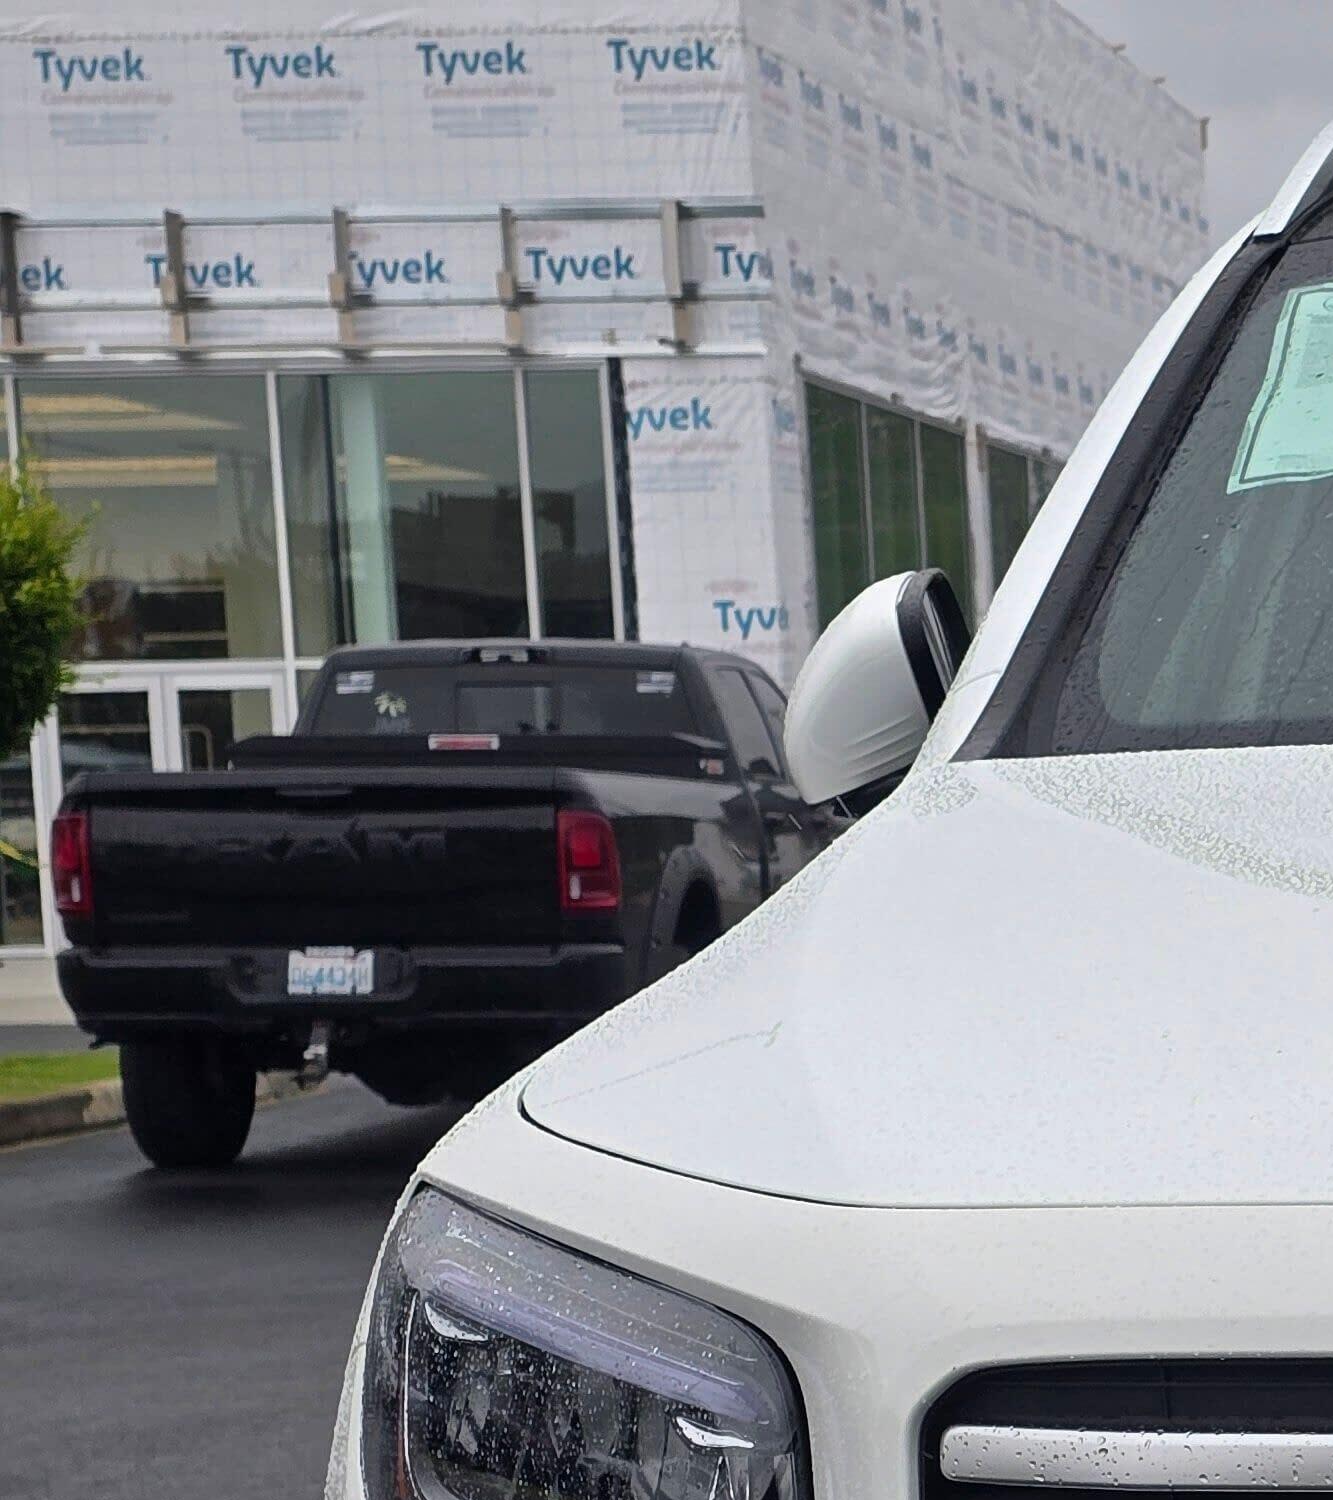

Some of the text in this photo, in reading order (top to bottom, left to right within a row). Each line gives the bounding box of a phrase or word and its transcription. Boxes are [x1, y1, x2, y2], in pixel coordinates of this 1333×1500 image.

[33, 47, 146, 91] Tyvek
[225, 43, 337, 87] Tyvek
[416, 39, 529, 84] Tyvek
[606, 37, 717, 82] Tyvek
[145, 252, 257, 288] Tvek
[349, 250, 448, 288] yvek
[525, 246, 635, 285] Tyvek
[625, 397, 713, 441] yvek
